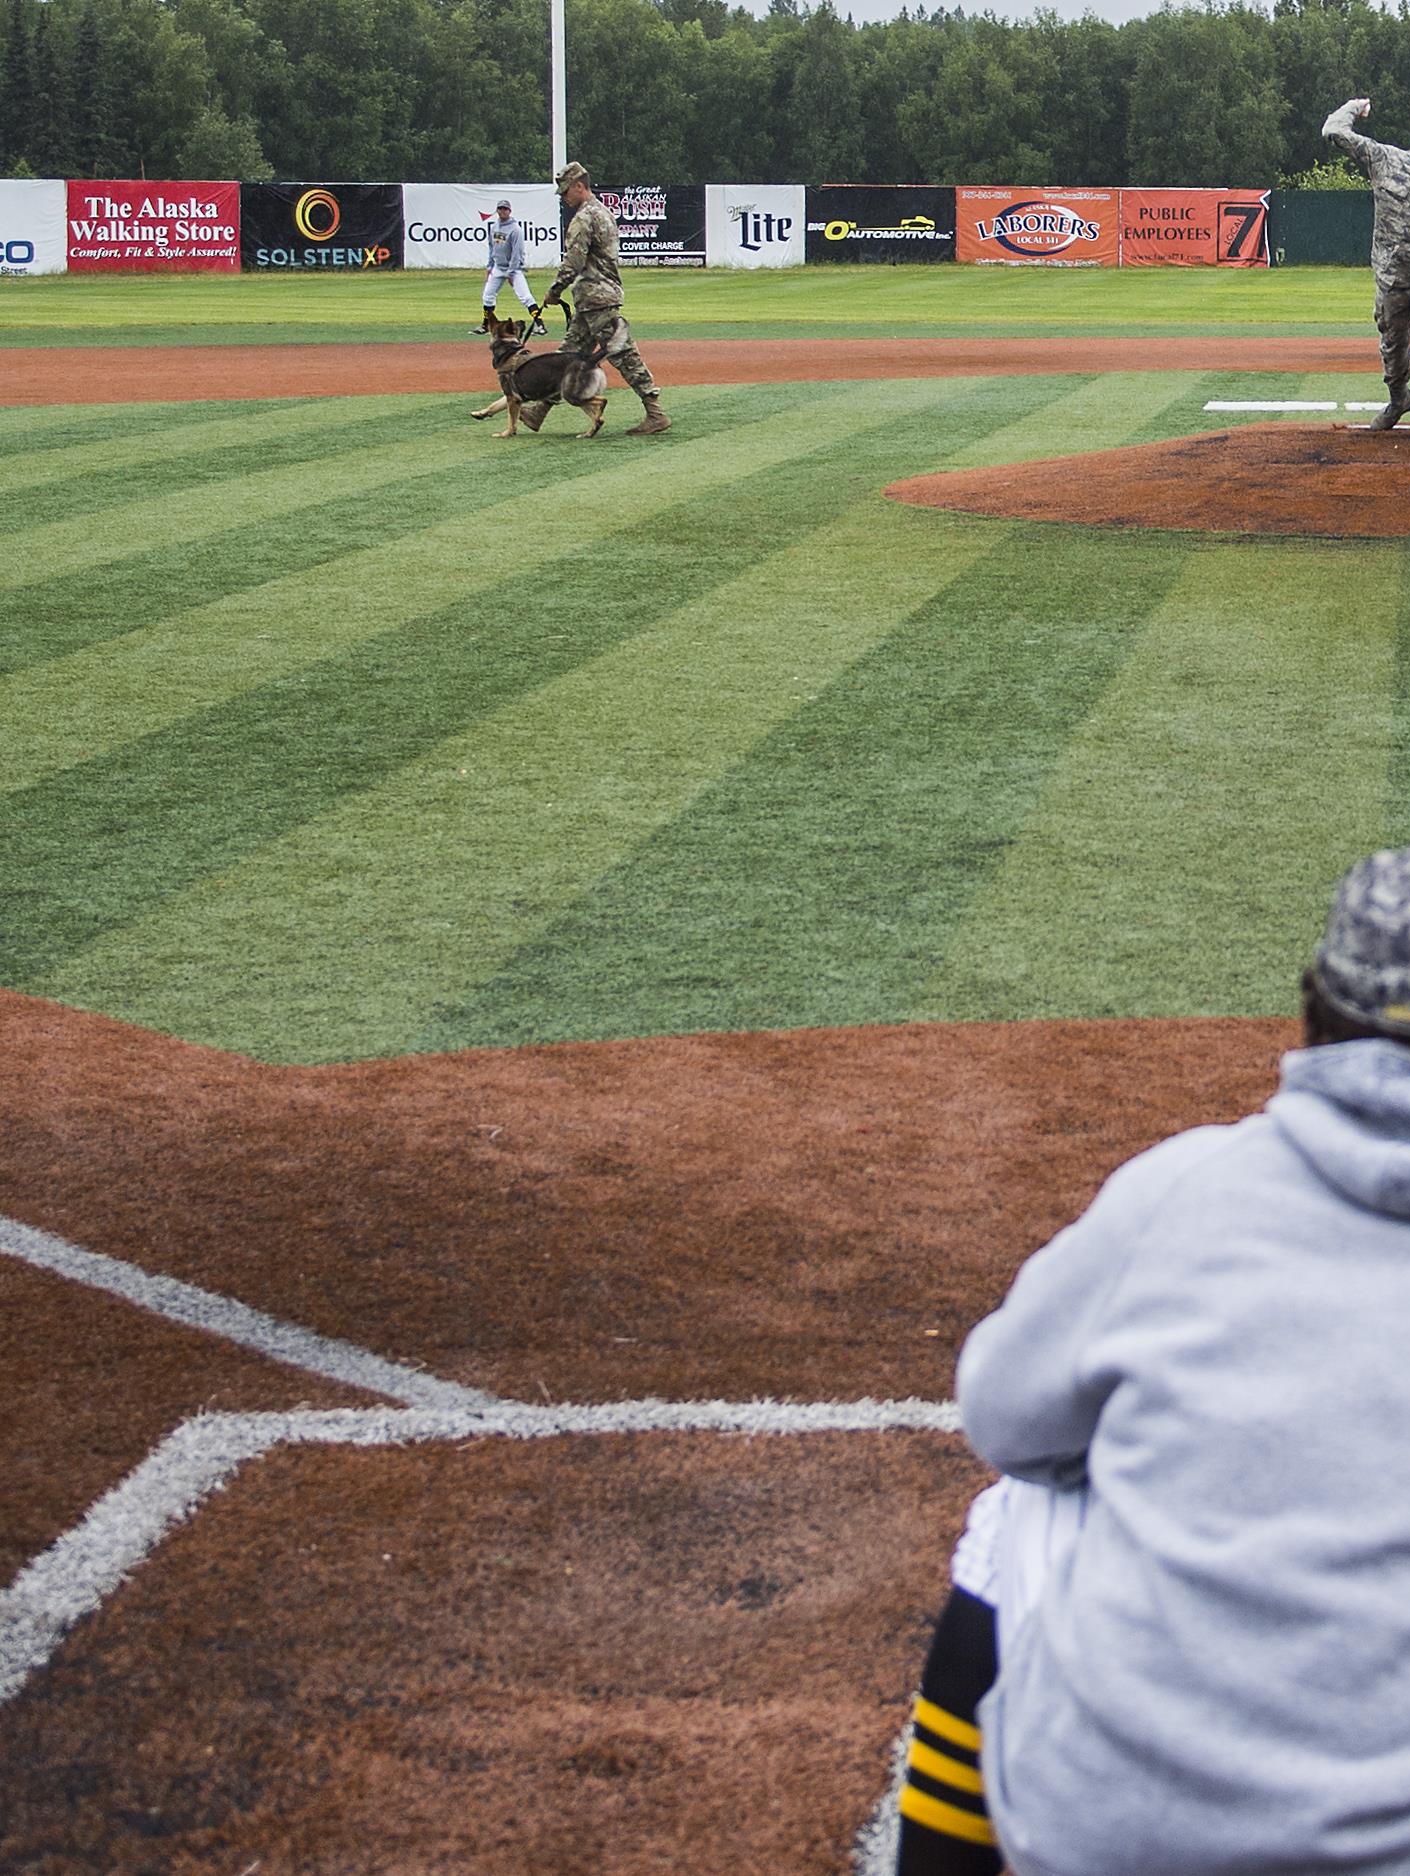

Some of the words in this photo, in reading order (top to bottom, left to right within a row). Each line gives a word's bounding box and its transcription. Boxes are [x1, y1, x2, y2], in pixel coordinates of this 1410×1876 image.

[624, 186, 635, 194] the
[622, 193, 667, 202] ALASKAN
[85, 197, 132, 218] The
[137, 197, 218, 218] Alaska
[600, 193, 667, 220] BUSH
[1139, 207, 1196, 220] PUBLIC
[70, 220, 169, 246] Walking
[175, 220, 235, 241] Store
[408, 221, 558, 246] Conocolips
[739, 211, 792, 251] Lite
[807, 223, 826, 231] BIG
[974, 213, 1100, 242] LABORERS
[1125, 227, 1211, 240] EMPLOYEES
[1224, 218, 1244, 246] LOCAL
[846, 230, 935, 240] AUTOMOTIVE
[1017, 236, 1044, 244] LOCAL
[0, 240, 35, 264] O
[70, 246, 121, 259] Comfort,
[125, 246, 142, 257] Fit
[144, 246, 156, 257] &
[157, 246, 185, 259] Style
[187, 246, 237, 257] Assured!
[622, 242, 650, 251] COVER
[651, 241, 684, 251] CHARGE
[256, 243, 391, 268] SOLSTENXP
[1, 266, 28, 275] Street
